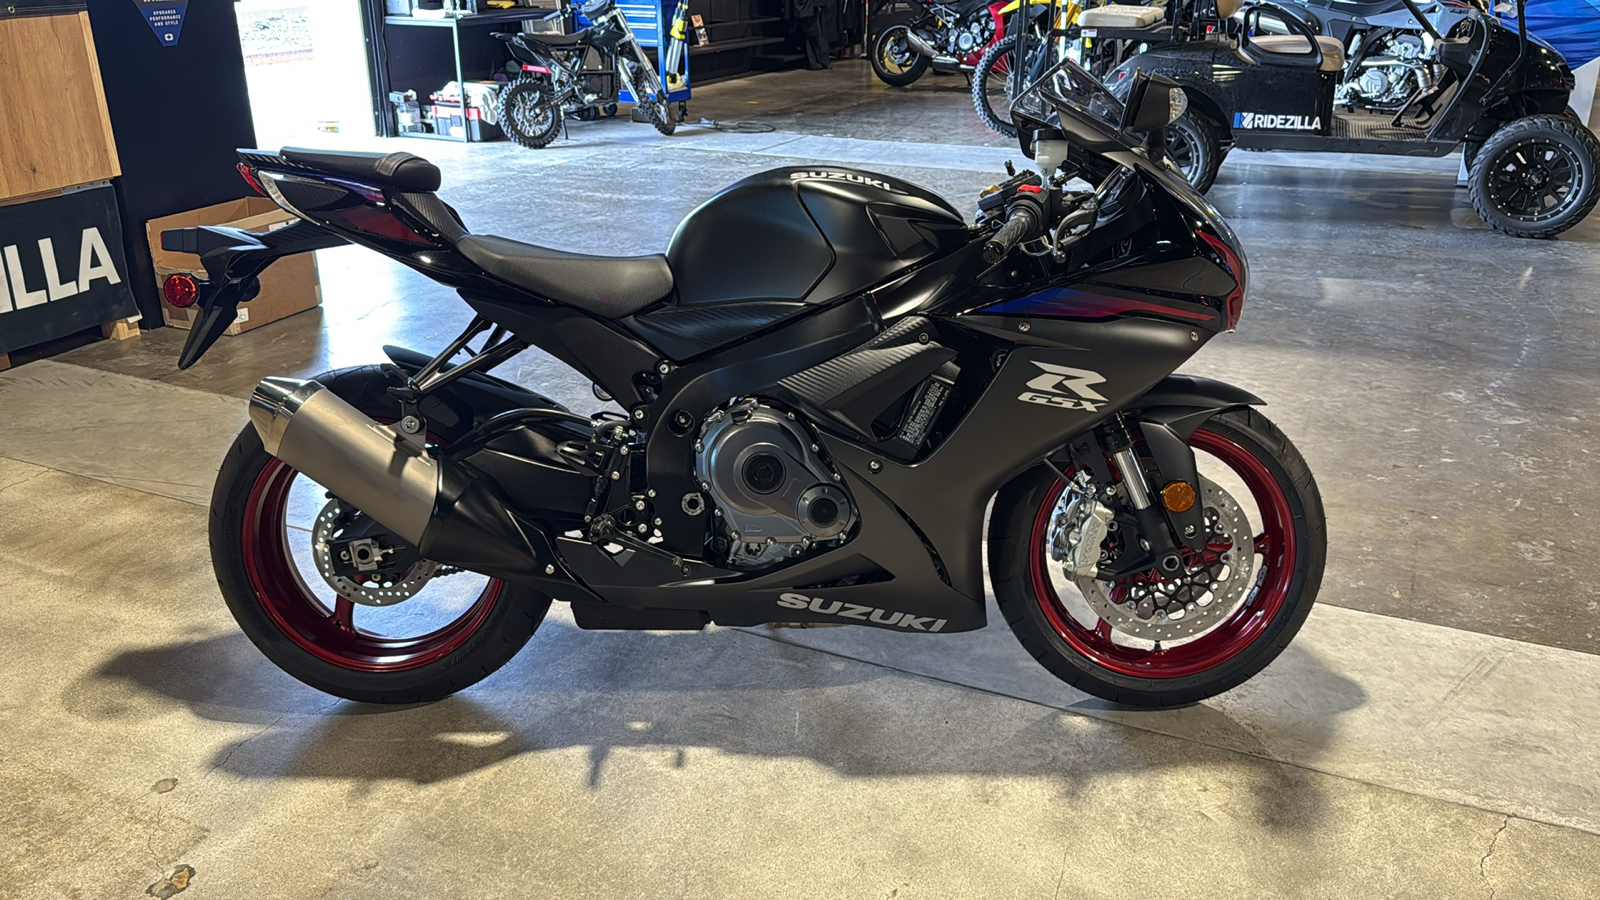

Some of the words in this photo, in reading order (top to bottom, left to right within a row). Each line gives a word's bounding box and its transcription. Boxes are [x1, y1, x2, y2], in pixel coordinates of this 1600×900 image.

[1253, 114, 1321, 130] RIDEZILLA
[790, 171, 891, 191] SUZUKI
[1018, 391, 1108, 412] GSX
[776, 593, 948, 632] SUZUKI
